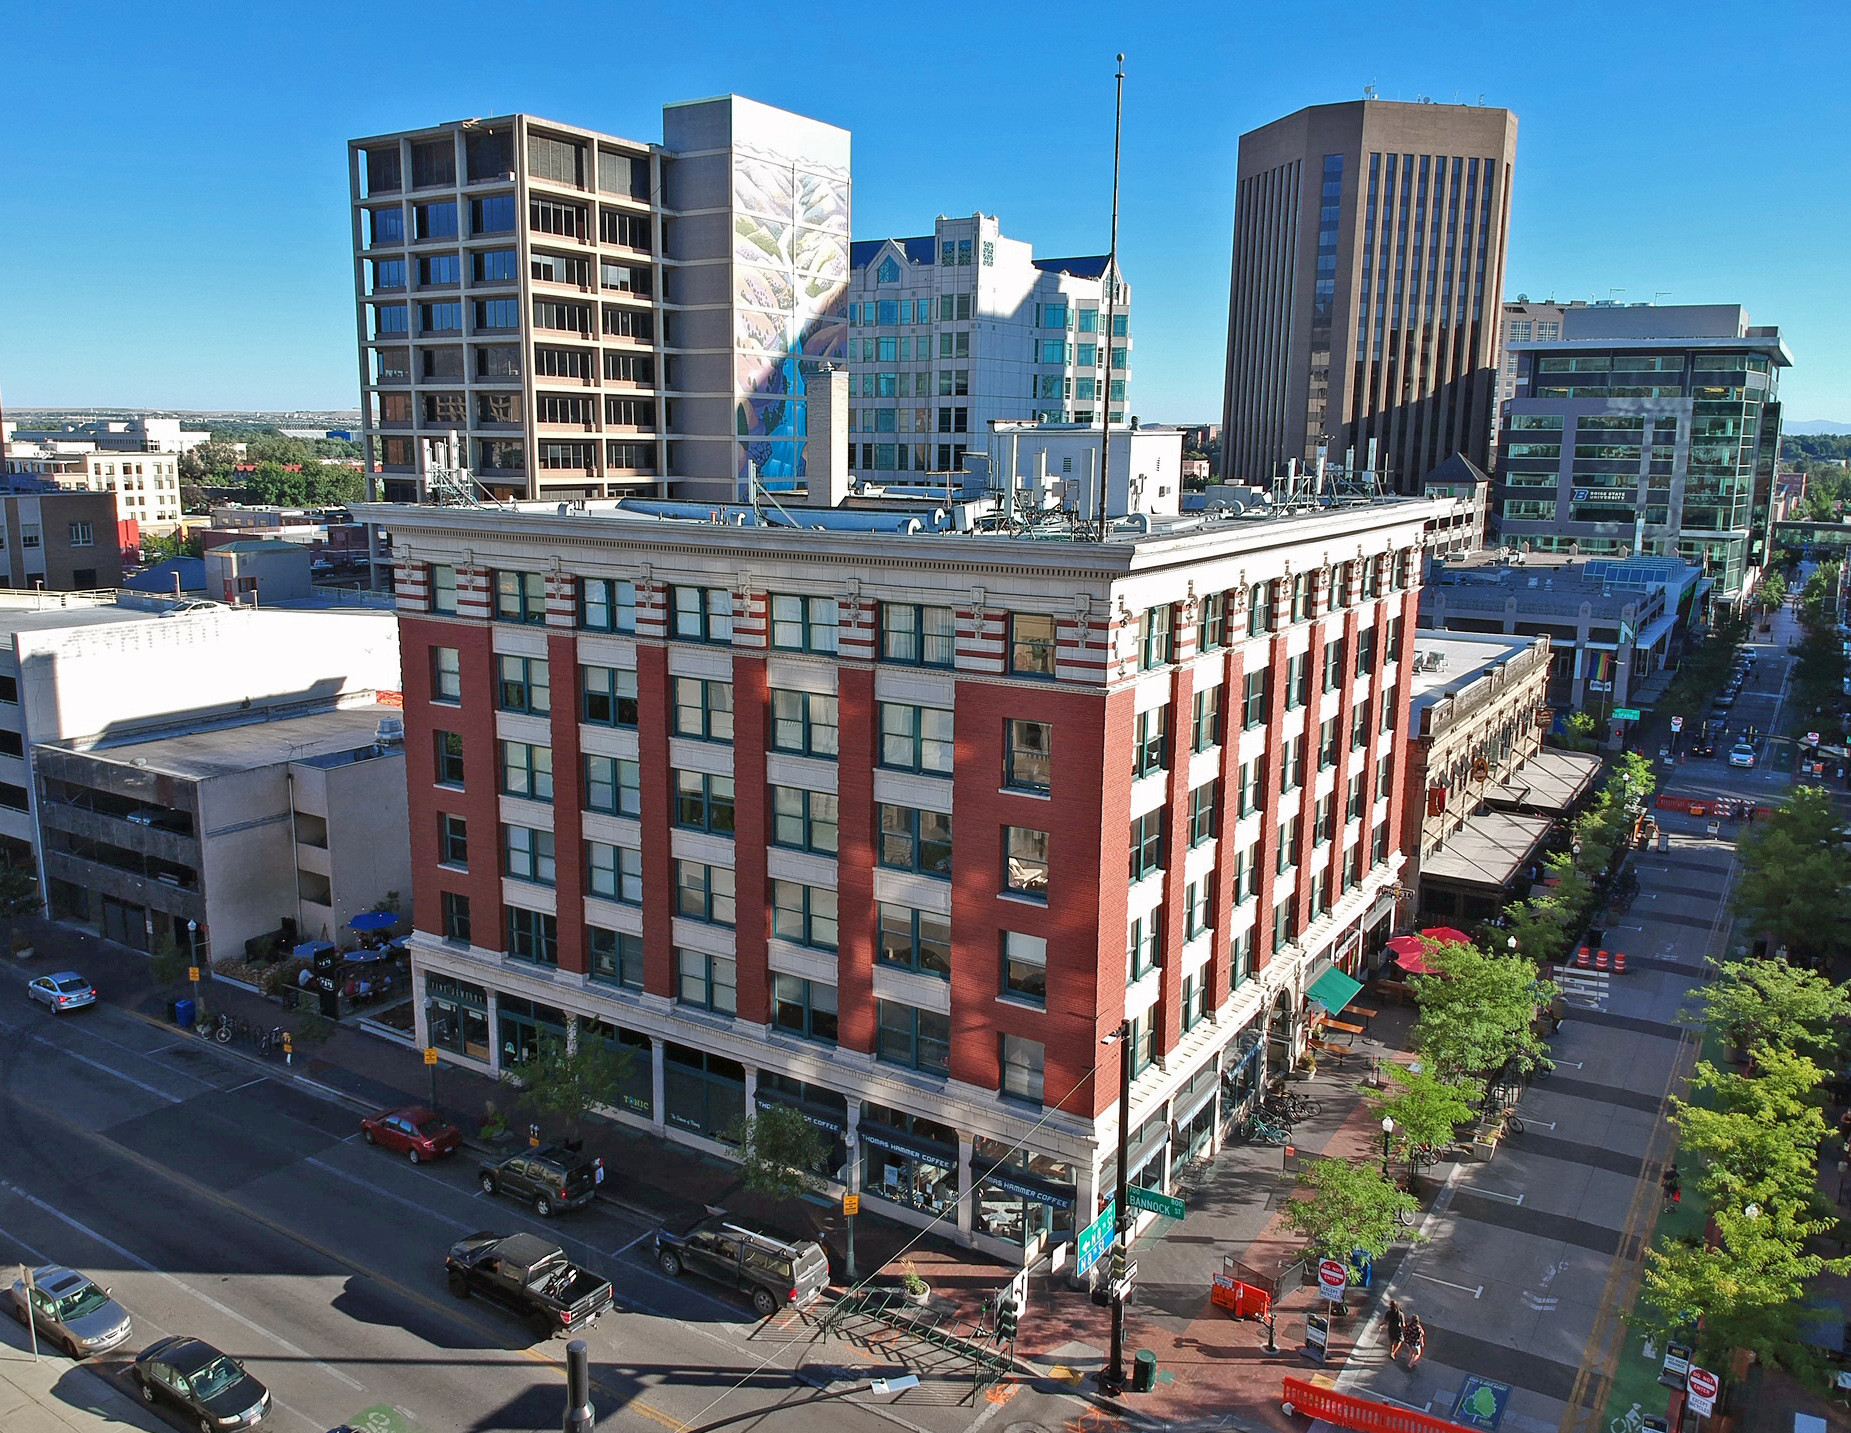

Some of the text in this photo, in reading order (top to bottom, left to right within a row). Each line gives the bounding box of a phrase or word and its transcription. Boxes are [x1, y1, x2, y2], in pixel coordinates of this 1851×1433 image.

[432, 981, 482, 1005] FINE JEWELRY
[813, 1118, 839, 1130] COFFEE
[861, 1134, 950, 1168] THOMAS HAMMER COFFEE
[1004, 1181, 1036, 1197] HAMMER
[1037, 1193, 1068, 1208] COFFEE
[1129, 1186, 1140, 1194] 700
[1129, 1195, 1171, 1216] BANNOCK
[1170, 1199, 1183, 1208] 800
[1091, 1232, 1096, 1246] N
[1107, 1215, 1113, 1229] St
[1081, 1257, 1086, 1272] N
[1099, 1239, 1105, 1254] St
[1323, 1274, 1340, 1283] ENTER
[1321, 1291, 1340, 1300] BICYCLES
[1323, 1286, 1338, 1295] EXCEPT
[1693, 1371, 1714, 1384] DO NOT
[1693, 1384, 1710, 1395] ENTER
[1689, 1401, 1710, 1414] BICYCLES
[1691, 1397, 1709, 1408] EXCEPT
